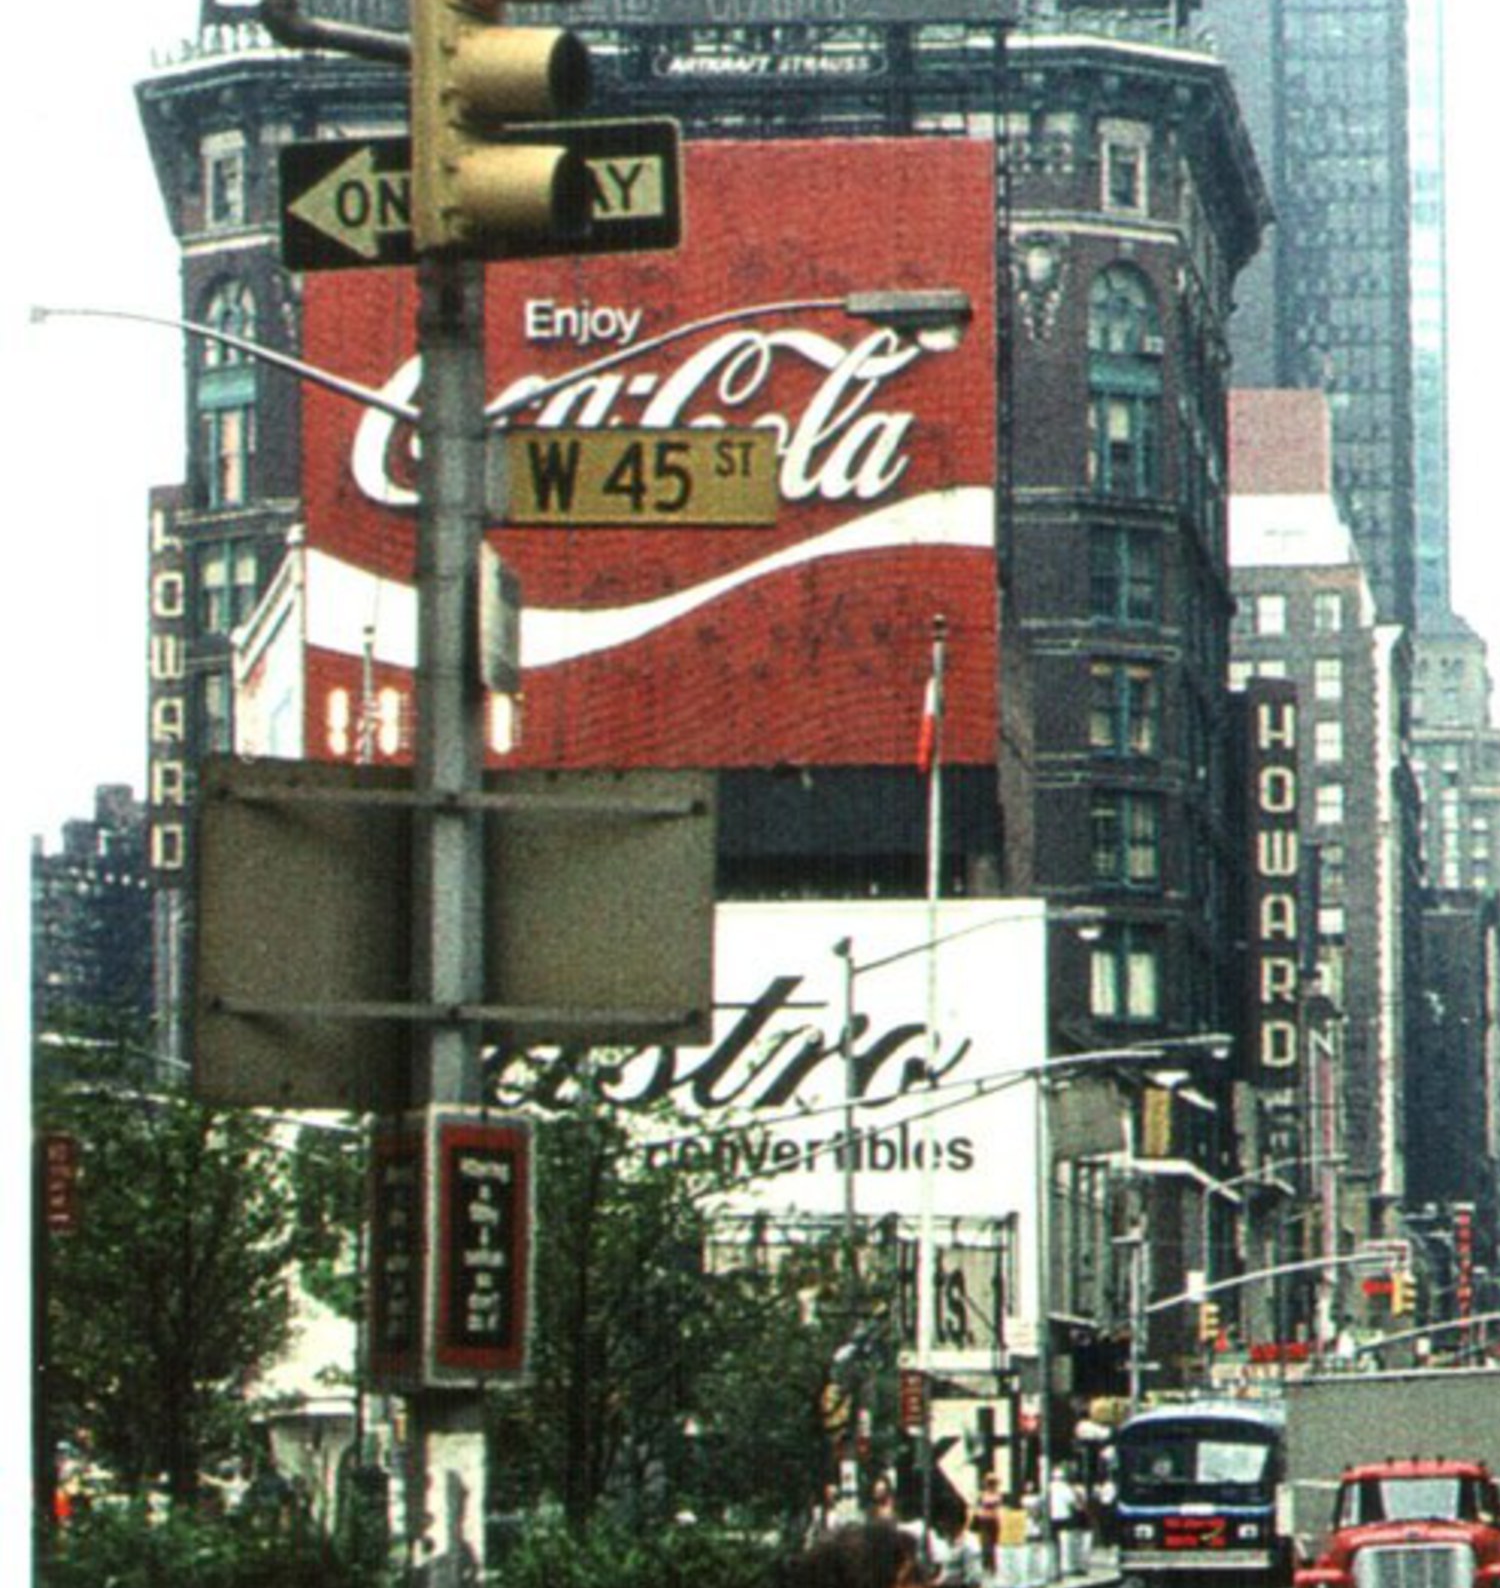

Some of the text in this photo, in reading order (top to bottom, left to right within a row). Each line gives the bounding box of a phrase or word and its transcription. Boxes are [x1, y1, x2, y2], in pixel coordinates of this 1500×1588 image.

[667, 53, 773, 75] ARTKRAFT
[335, 178, 411, 230] ON
[524, 297, 643, 341] Enjoy
[528, 441, 755, 512] W 45 ST
[150, 507, 184, 870] HOWARD
[1257, 702, 1299, 1068] HOWARD
[482, 975, 973, 1110] astro
